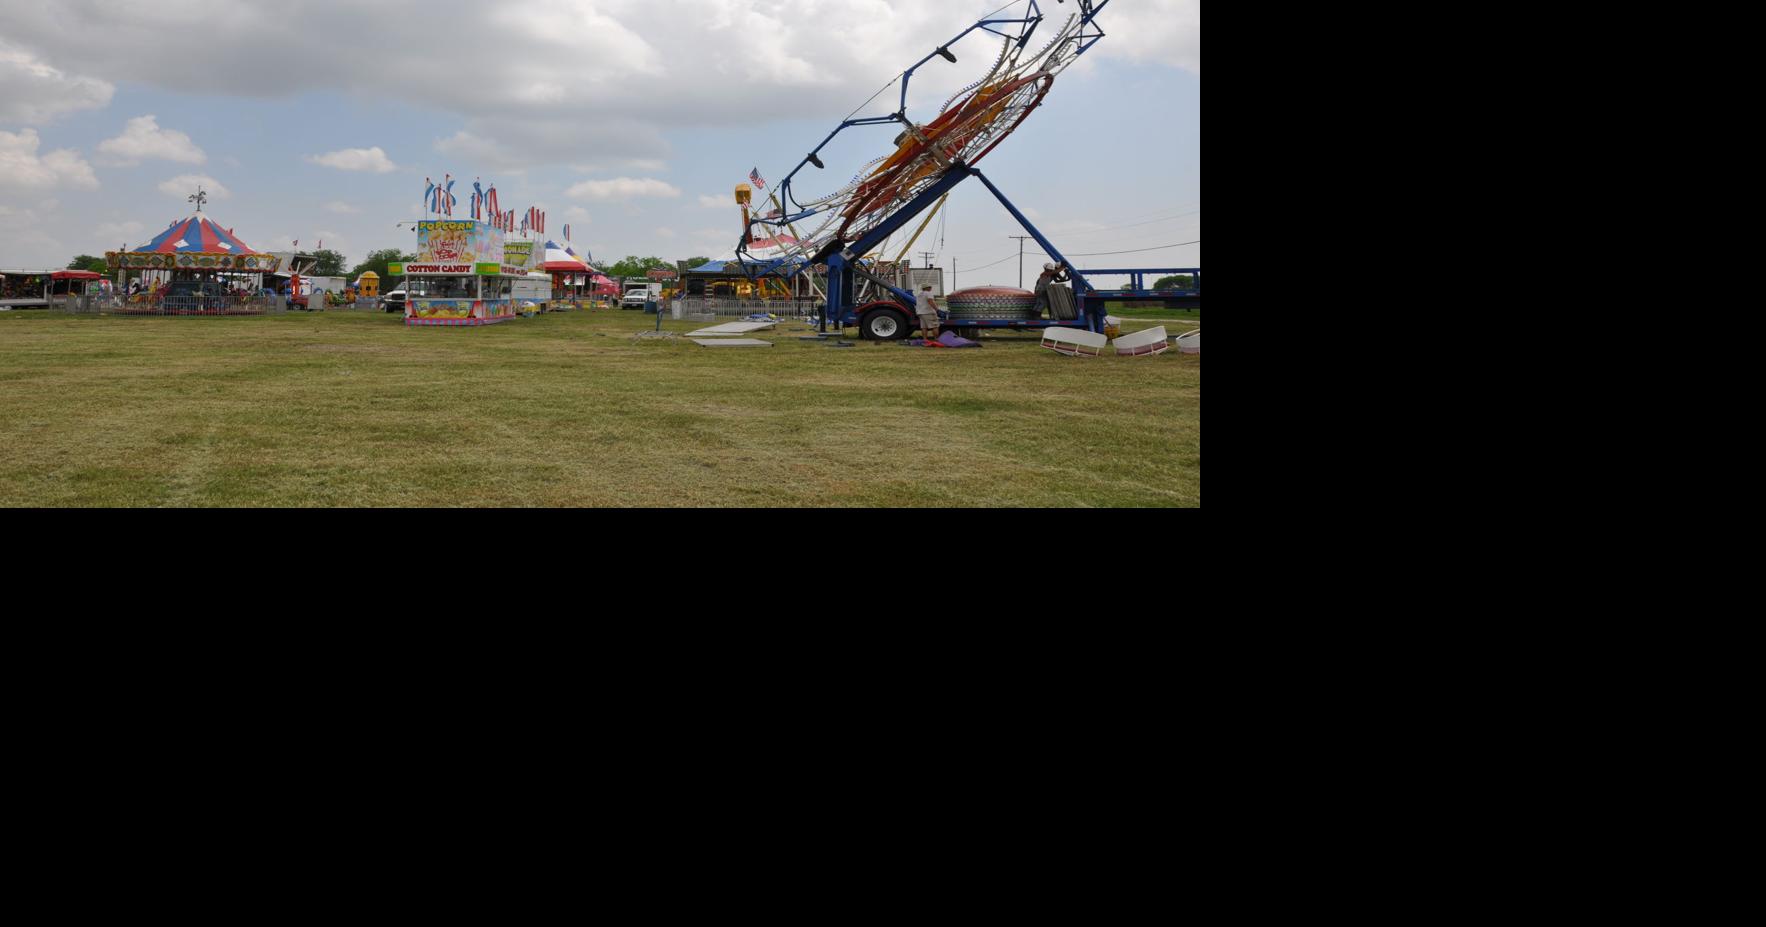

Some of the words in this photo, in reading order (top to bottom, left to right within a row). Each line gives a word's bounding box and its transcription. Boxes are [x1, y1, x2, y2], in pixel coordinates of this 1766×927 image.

[419, 221, 474, 231] POPCORN
[406, 265, 440, 273] COTTON
[442, 265, 472, 273] CANDY
